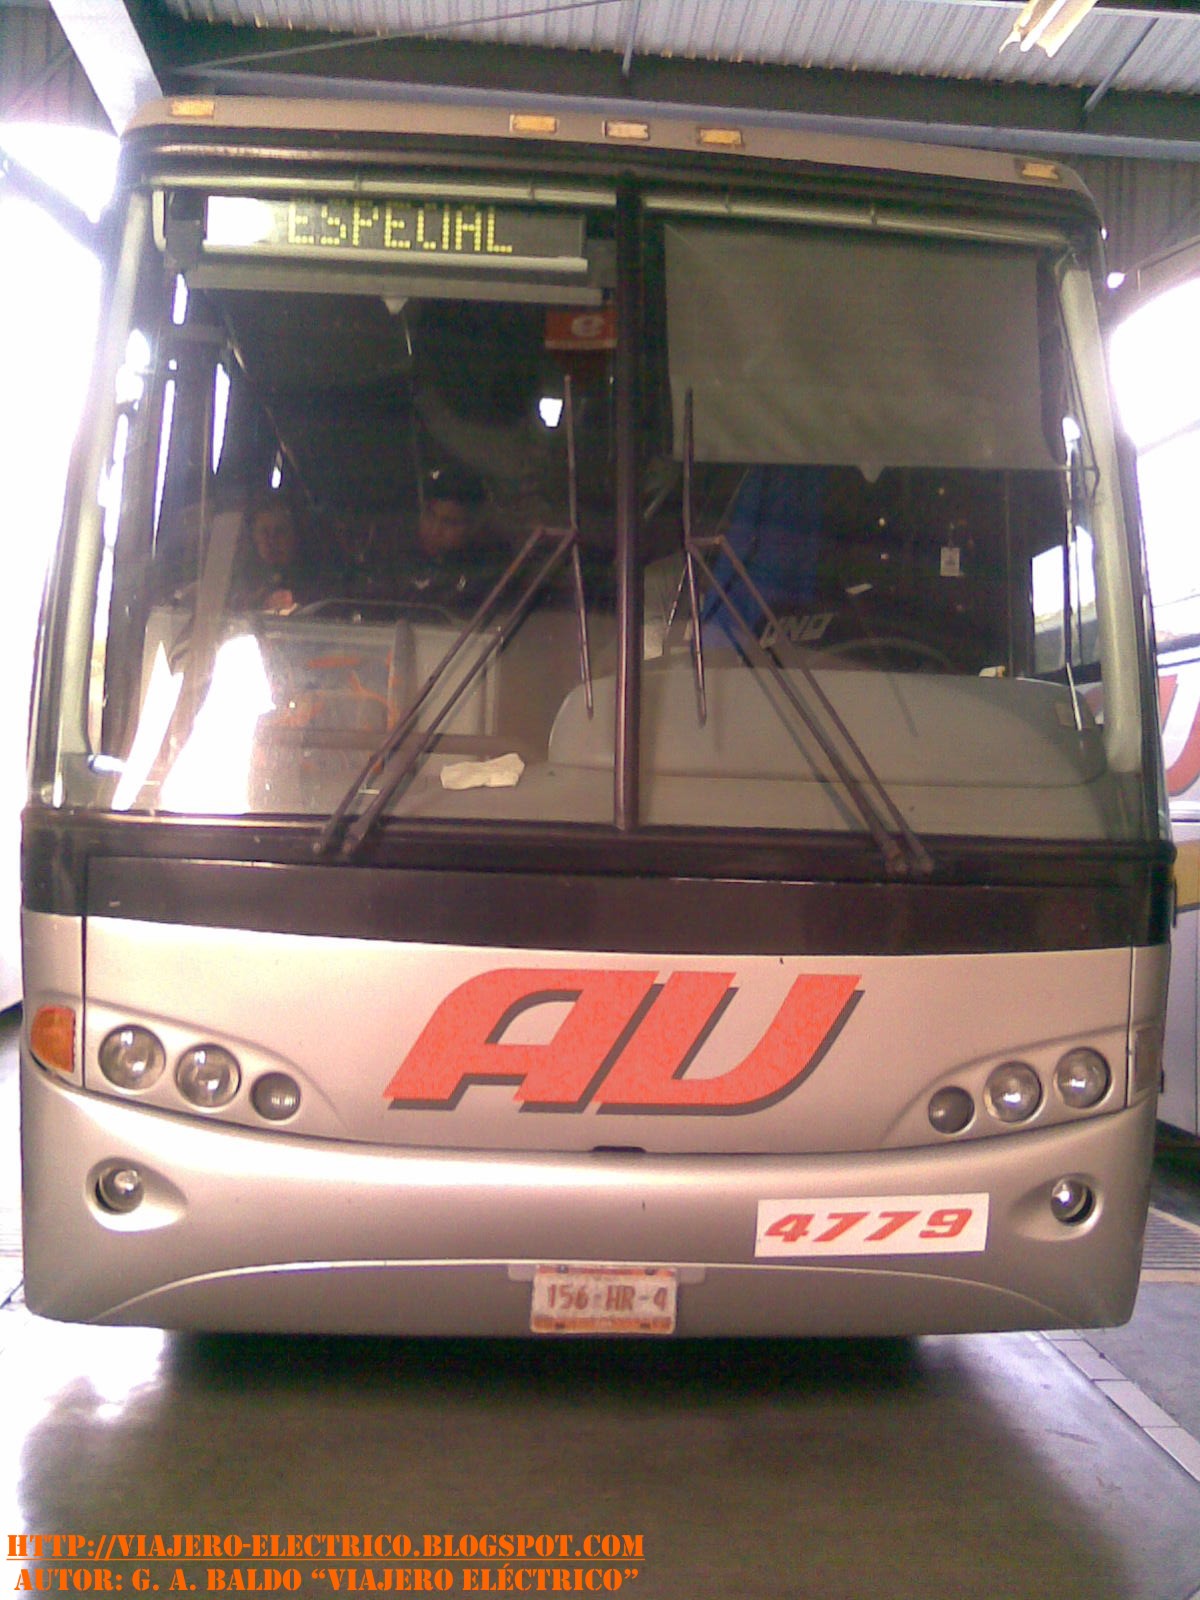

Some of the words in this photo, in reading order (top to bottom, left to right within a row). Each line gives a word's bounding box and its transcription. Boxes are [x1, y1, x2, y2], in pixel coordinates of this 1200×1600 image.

[287, 200, 513, 253] ESPECIAL
[383, 967, 865, 1116] AU
[764, 1208, 974, 1243] 4779
